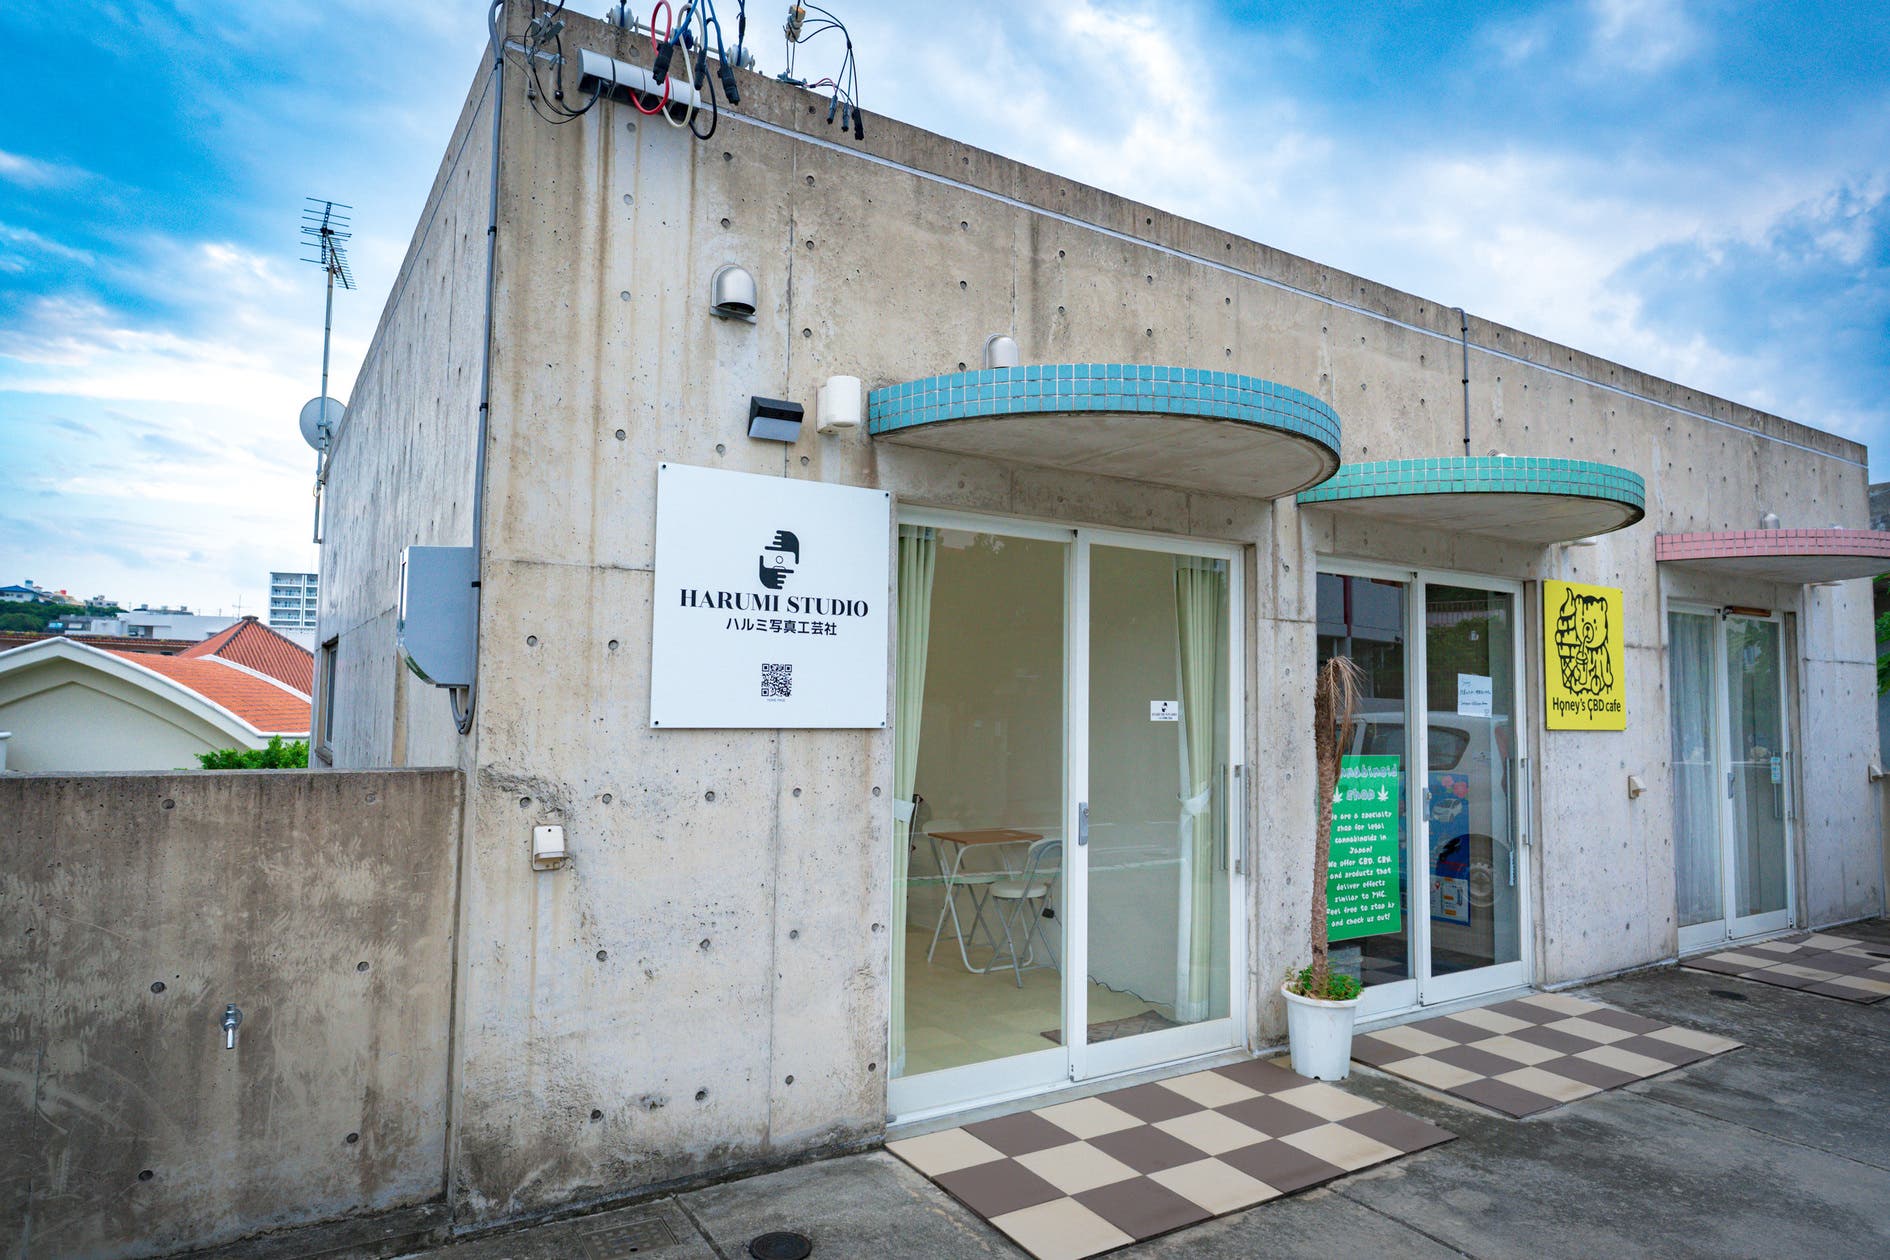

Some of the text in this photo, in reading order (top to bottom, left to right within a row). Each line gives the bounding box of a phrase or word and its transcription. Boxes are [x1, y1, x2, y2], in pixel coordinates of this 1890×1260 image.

[680, 588, 869, 617] HARUMI STUDIO
[726, 617, 838, 636] ハルミ写真工芸社
[1552, 696, 1621, 719] Honey's CBD cafe
[1354, 823, 1365, 831] for
[1340, 859, 1356, 867] offer
[1330, 867, 1391, 880] and products that
[1336, 880, 1385, 891] deliver effects
[1334, 895, 1359, 903] similar
[1344, 906, 1358, 914] free
[1371, 903, 1385, 911] stop
[1331, 918, 1344, 927] and
[1346, 916, 1364, 925] check
